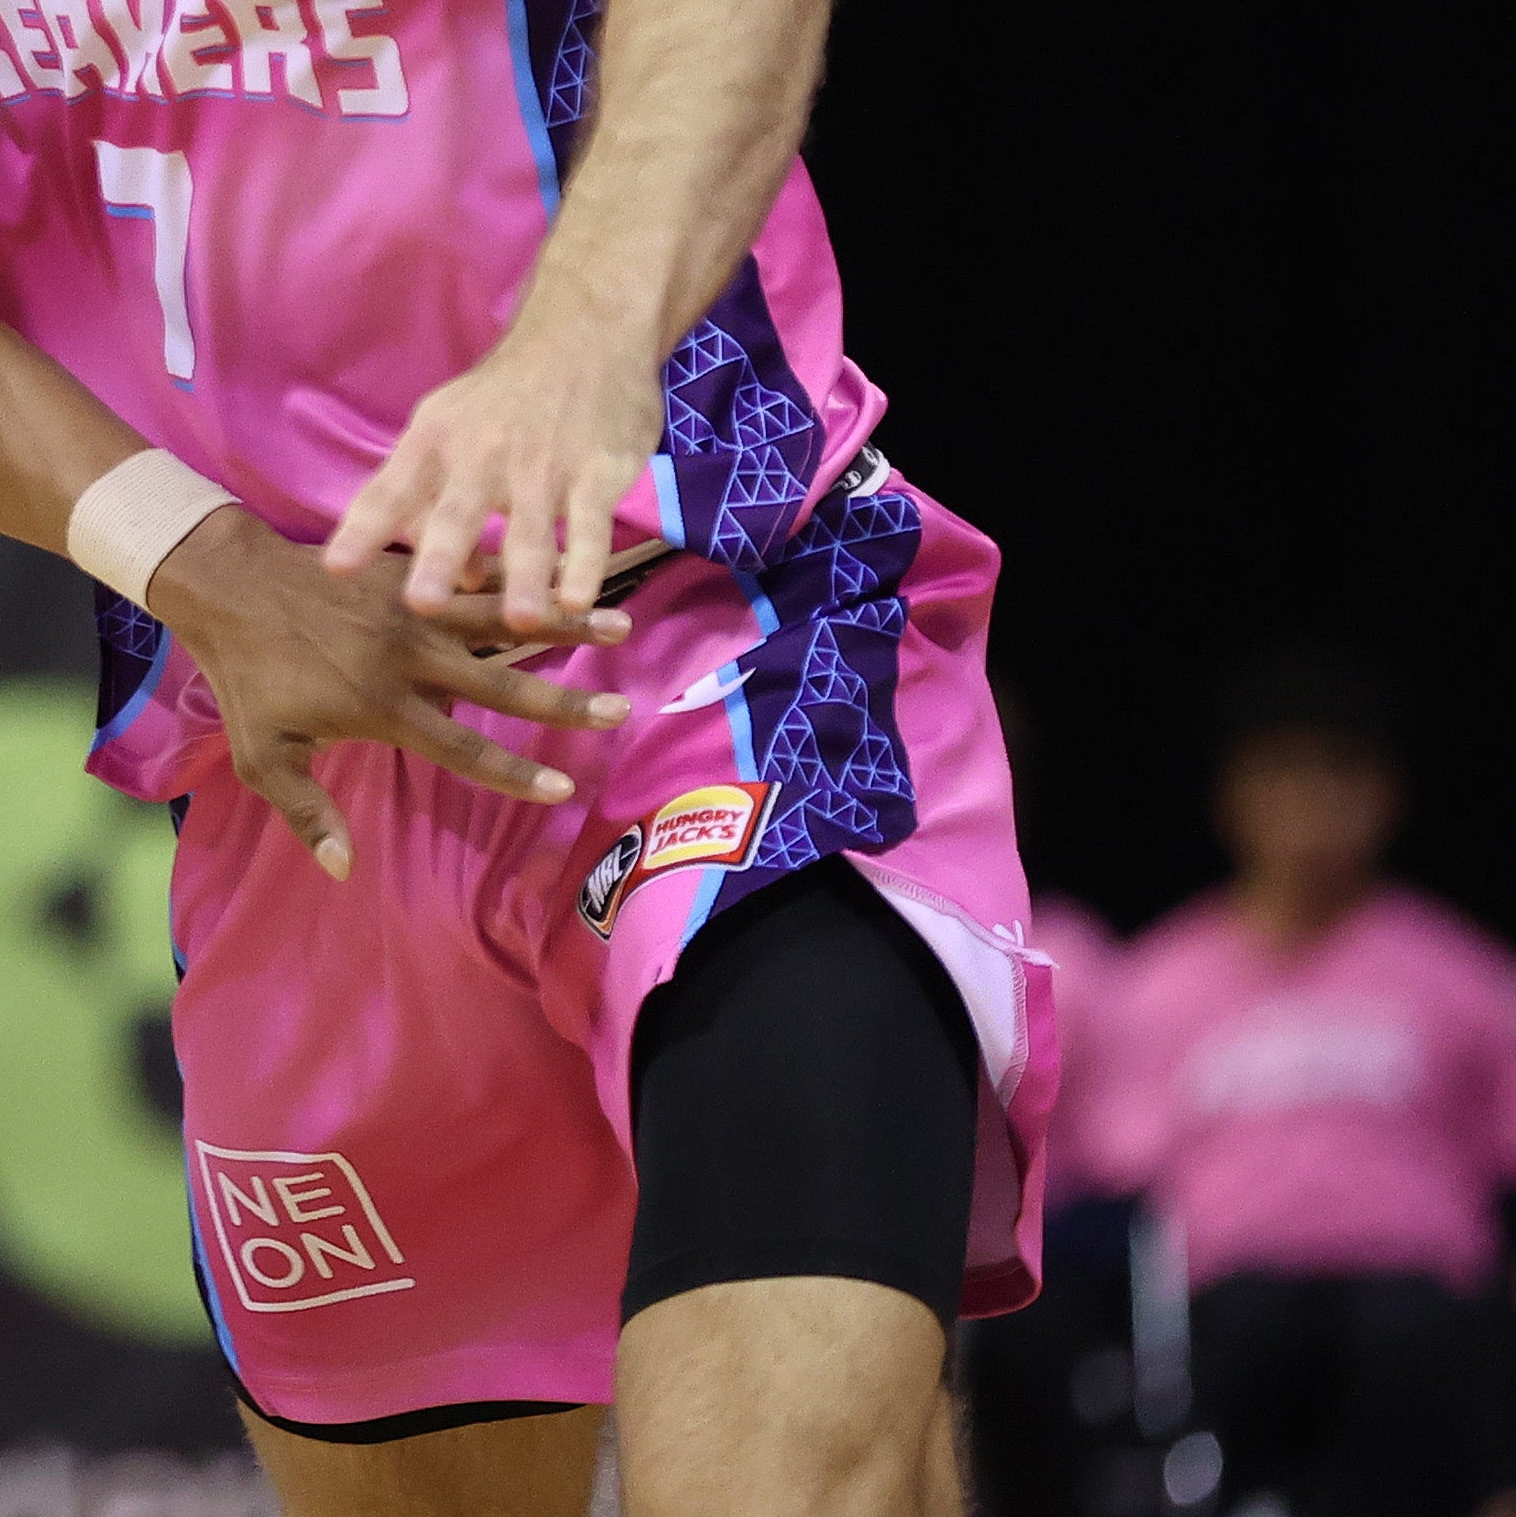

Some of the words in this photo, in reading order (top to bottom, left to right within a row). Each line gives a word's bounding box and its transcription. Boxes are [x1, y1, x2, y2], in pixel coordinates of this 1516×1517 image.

[94, 139, 197, 391] 7
[655, 809, 745, 836] HUNGRY
[587, 844, 624, 913] NBL
[217, 1172, 346, 1227] NE
[240, 1224, 376, 1288] ON
